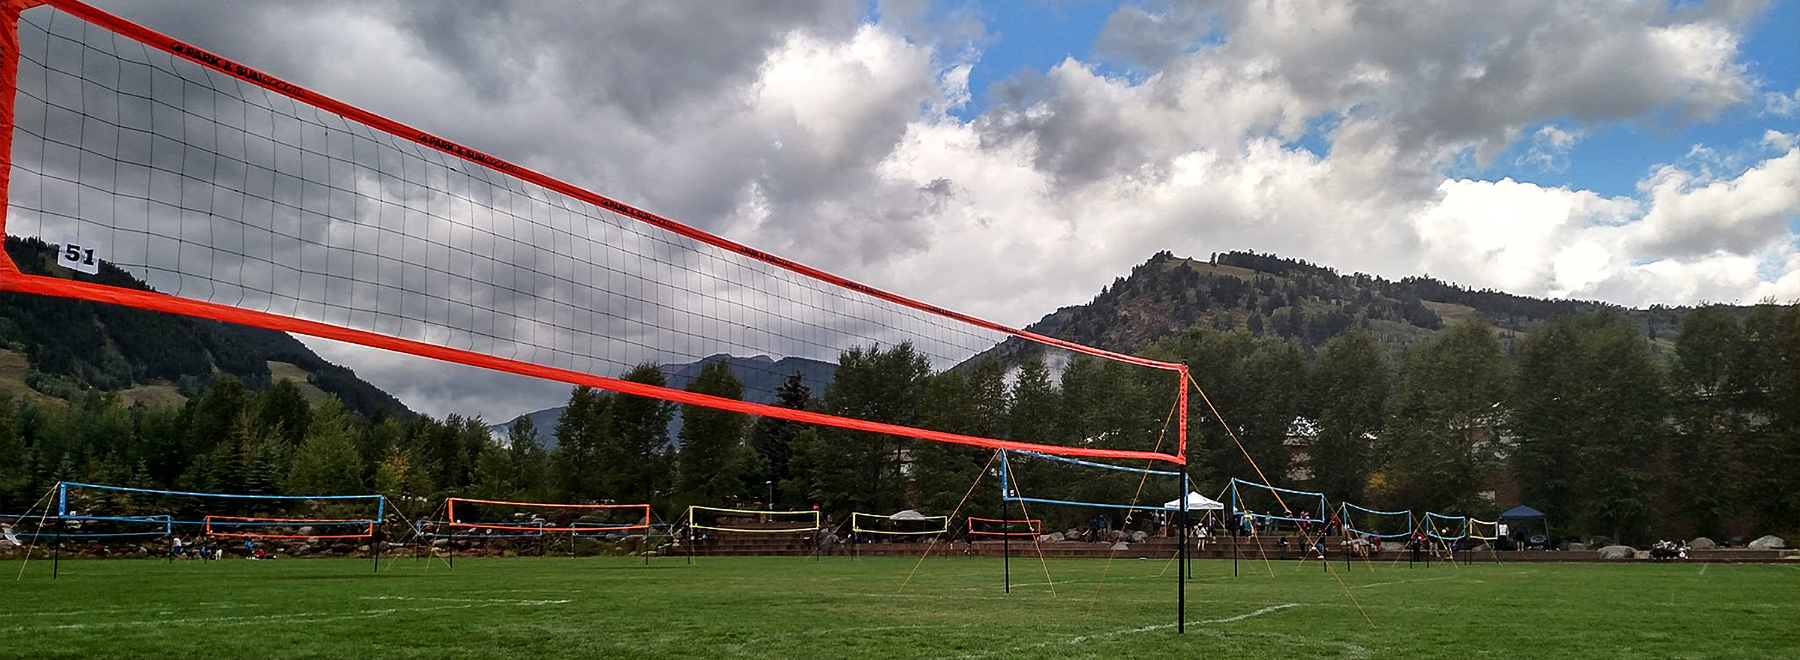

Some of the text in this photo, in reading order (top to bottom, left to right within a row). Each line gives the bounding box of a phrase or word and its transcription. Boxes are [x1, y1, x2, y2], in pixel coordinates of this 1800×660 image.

[185, 45, 221, 67] PARK
[222, 60, 233, 72] &
[235, 64, 261, 82] SUN
[65, 244, 94, 265] 51
